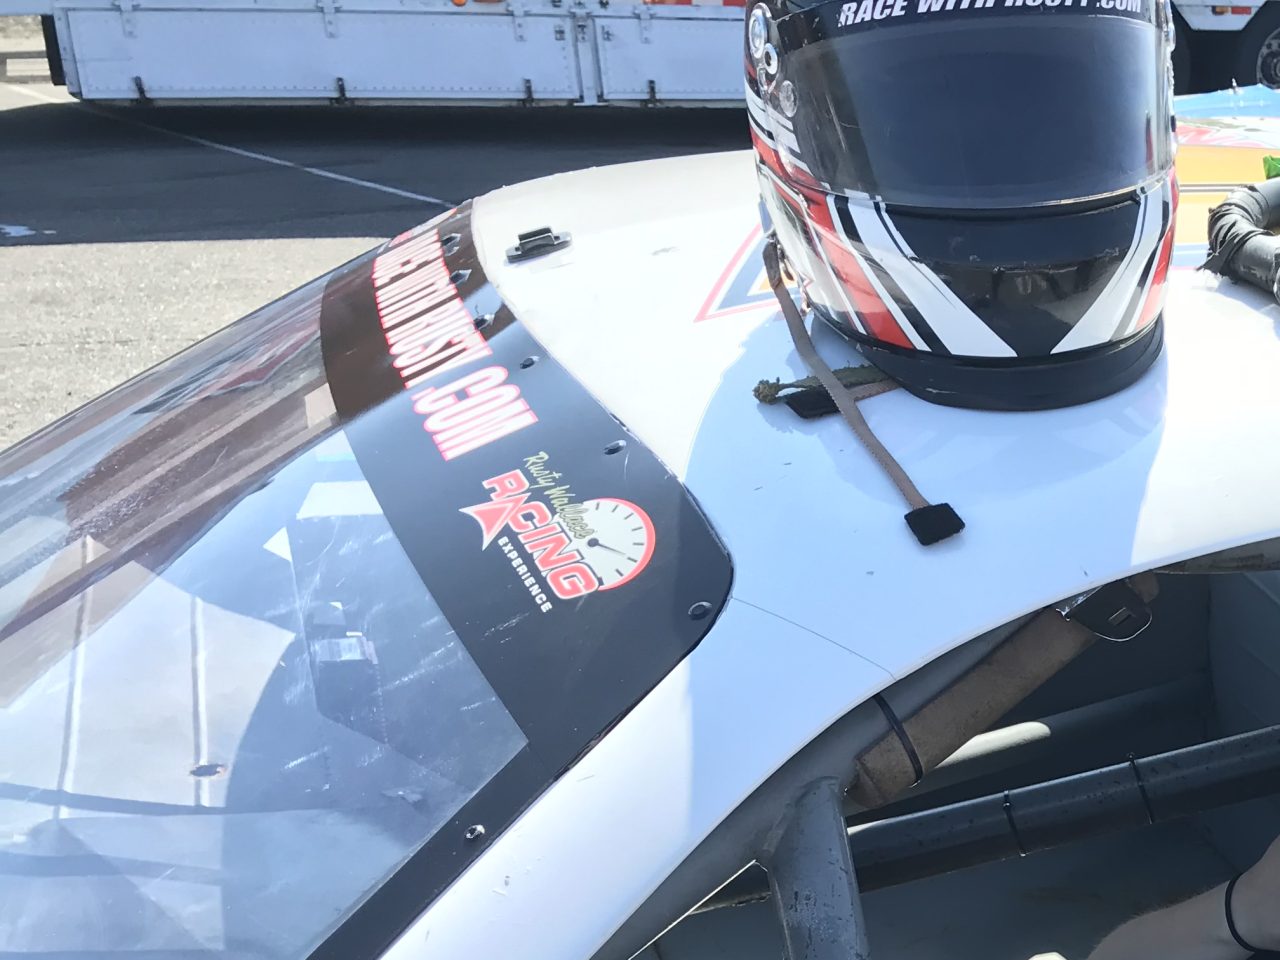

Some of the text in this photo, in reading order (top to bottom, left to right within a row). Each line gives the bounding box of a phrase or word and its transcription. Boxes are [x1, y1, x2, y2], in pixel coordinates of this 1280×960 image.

[385, 296, 493, 389] RUSTY
[472, 468, 600, 600] RACING
[497, 535, 553, 613] EXPERIENCE
